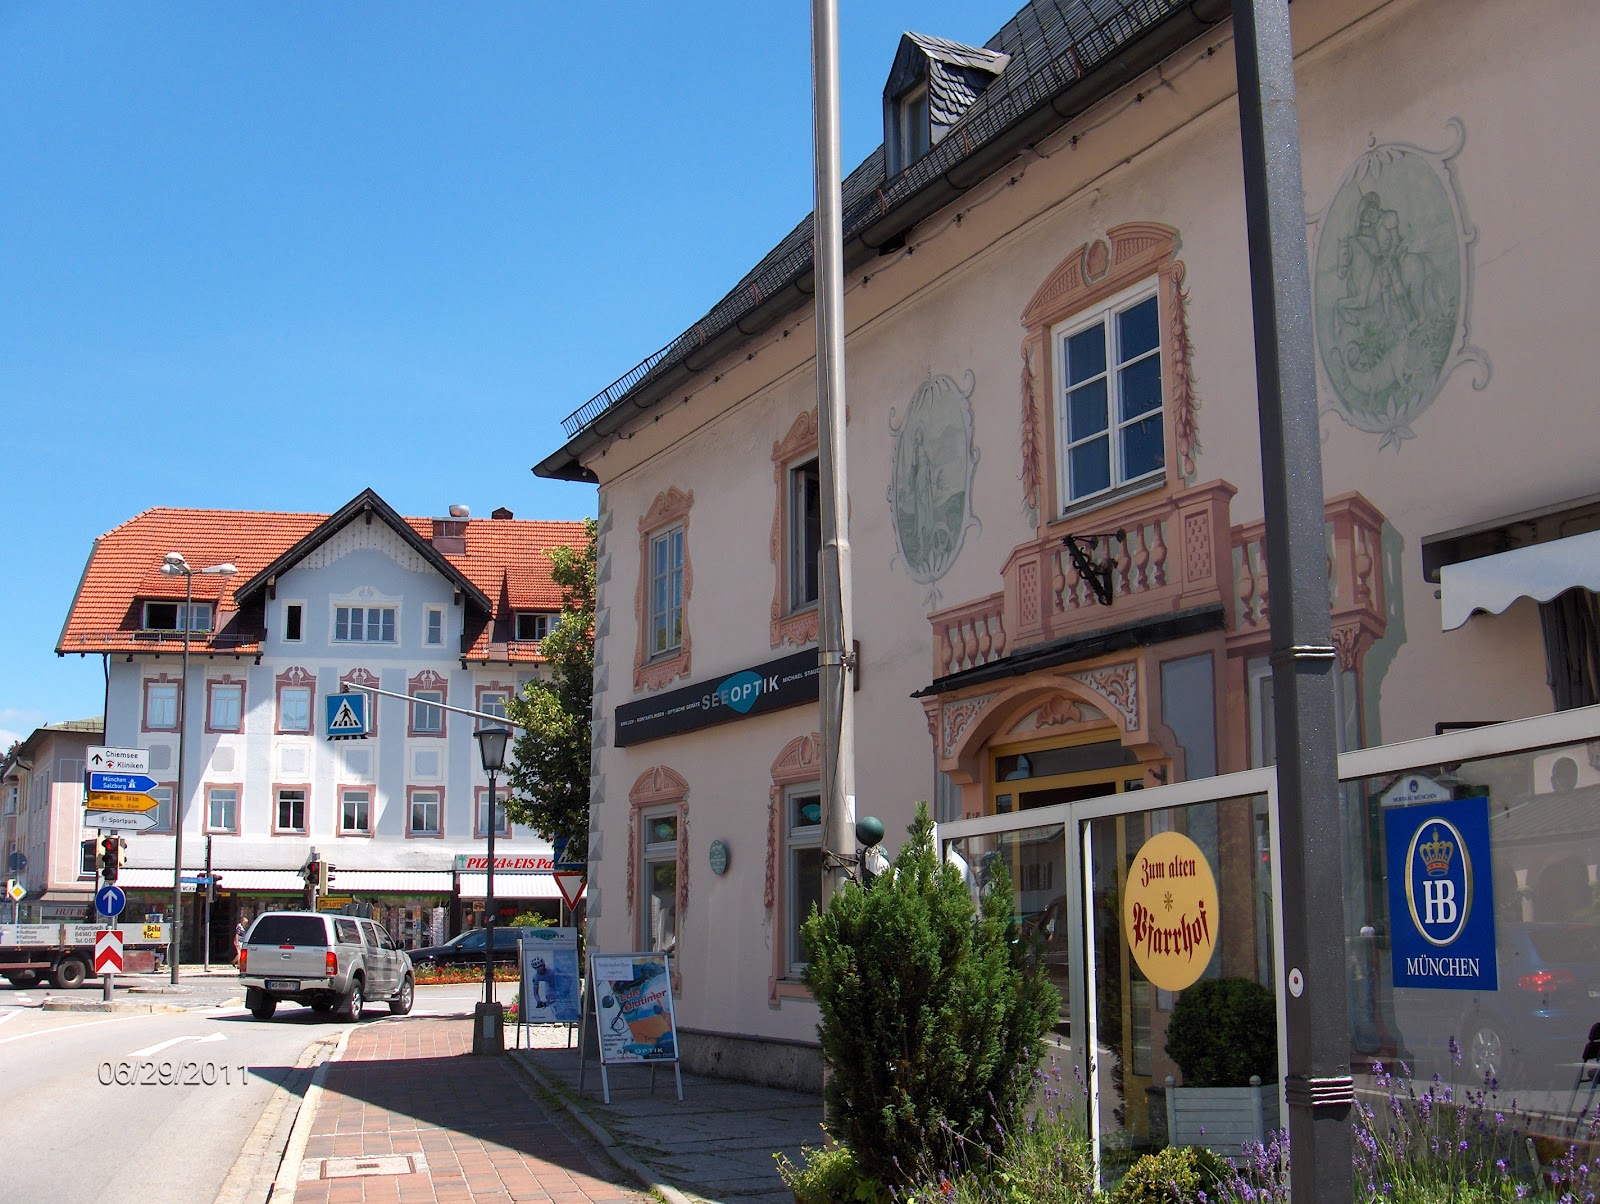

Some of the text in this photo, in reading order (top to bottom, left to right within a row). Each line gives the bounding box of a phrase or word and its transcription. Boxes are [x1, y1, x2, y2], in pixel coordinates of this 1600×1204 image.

[636, 712, 664, 722] KONTAKTLINSEN
[668, 706, 686, 714] OPTISCHE
[702, 674, 780, 710] SEEOPTIK
[782, 672, 803, 683] MICHAEL
[467, 858, 507, 868] PIZZA
[514, 859, 536, 868] EIS
[1141, 854, 1196, 888] Zum alten
[1423, 880, 1457, 924] HB
[1133, 898, 1210, 964] Pfarrhof
[1406, 954, 1480, 977] MÜNCHEN
[620, 990, 641, 1002] Edle
[624, 990, 667, 1012] Oldtimer
